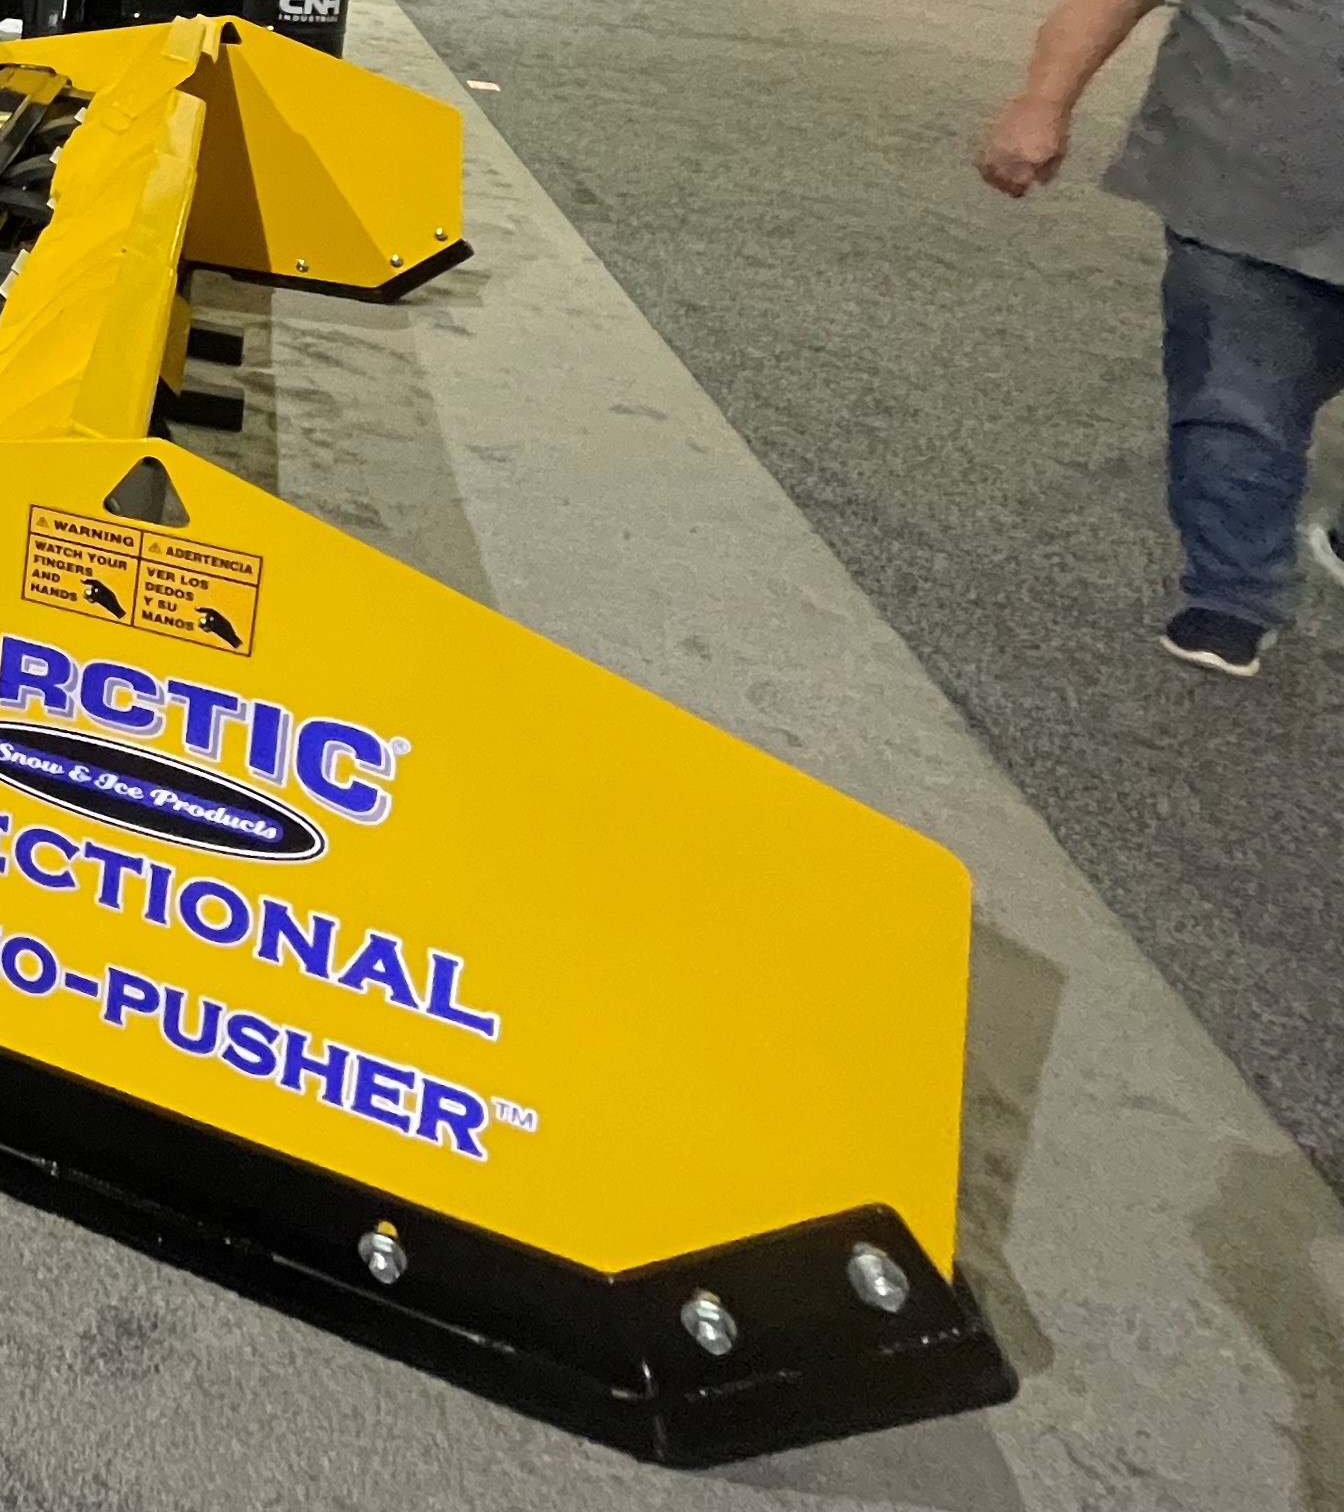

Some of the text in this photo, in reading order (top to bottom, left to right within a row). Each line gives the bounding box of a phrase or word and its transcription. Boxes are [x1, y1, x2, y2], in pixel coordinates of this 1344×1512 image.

[53, 519, 135, 547] WARNING
[33, 555, 93, 577] FINGERS
[34, 540, 128, 571] WATCH YOUR
[165, 546, 253, 575] ADERTENCIA
[31, 569, 61, 583] AND
[146, 566, 209, 590] VER LOS
[30, 583, 78, 602] HANDS
[143, 595, 153, 606] Y
[144, 581, 194, 601] DEDOS
[141, 610, 194, 631] MANOS
[68, 765, 92, 783] &
[94, 772, 144, 800] Ice
[151, 789, 278, 841] Products
